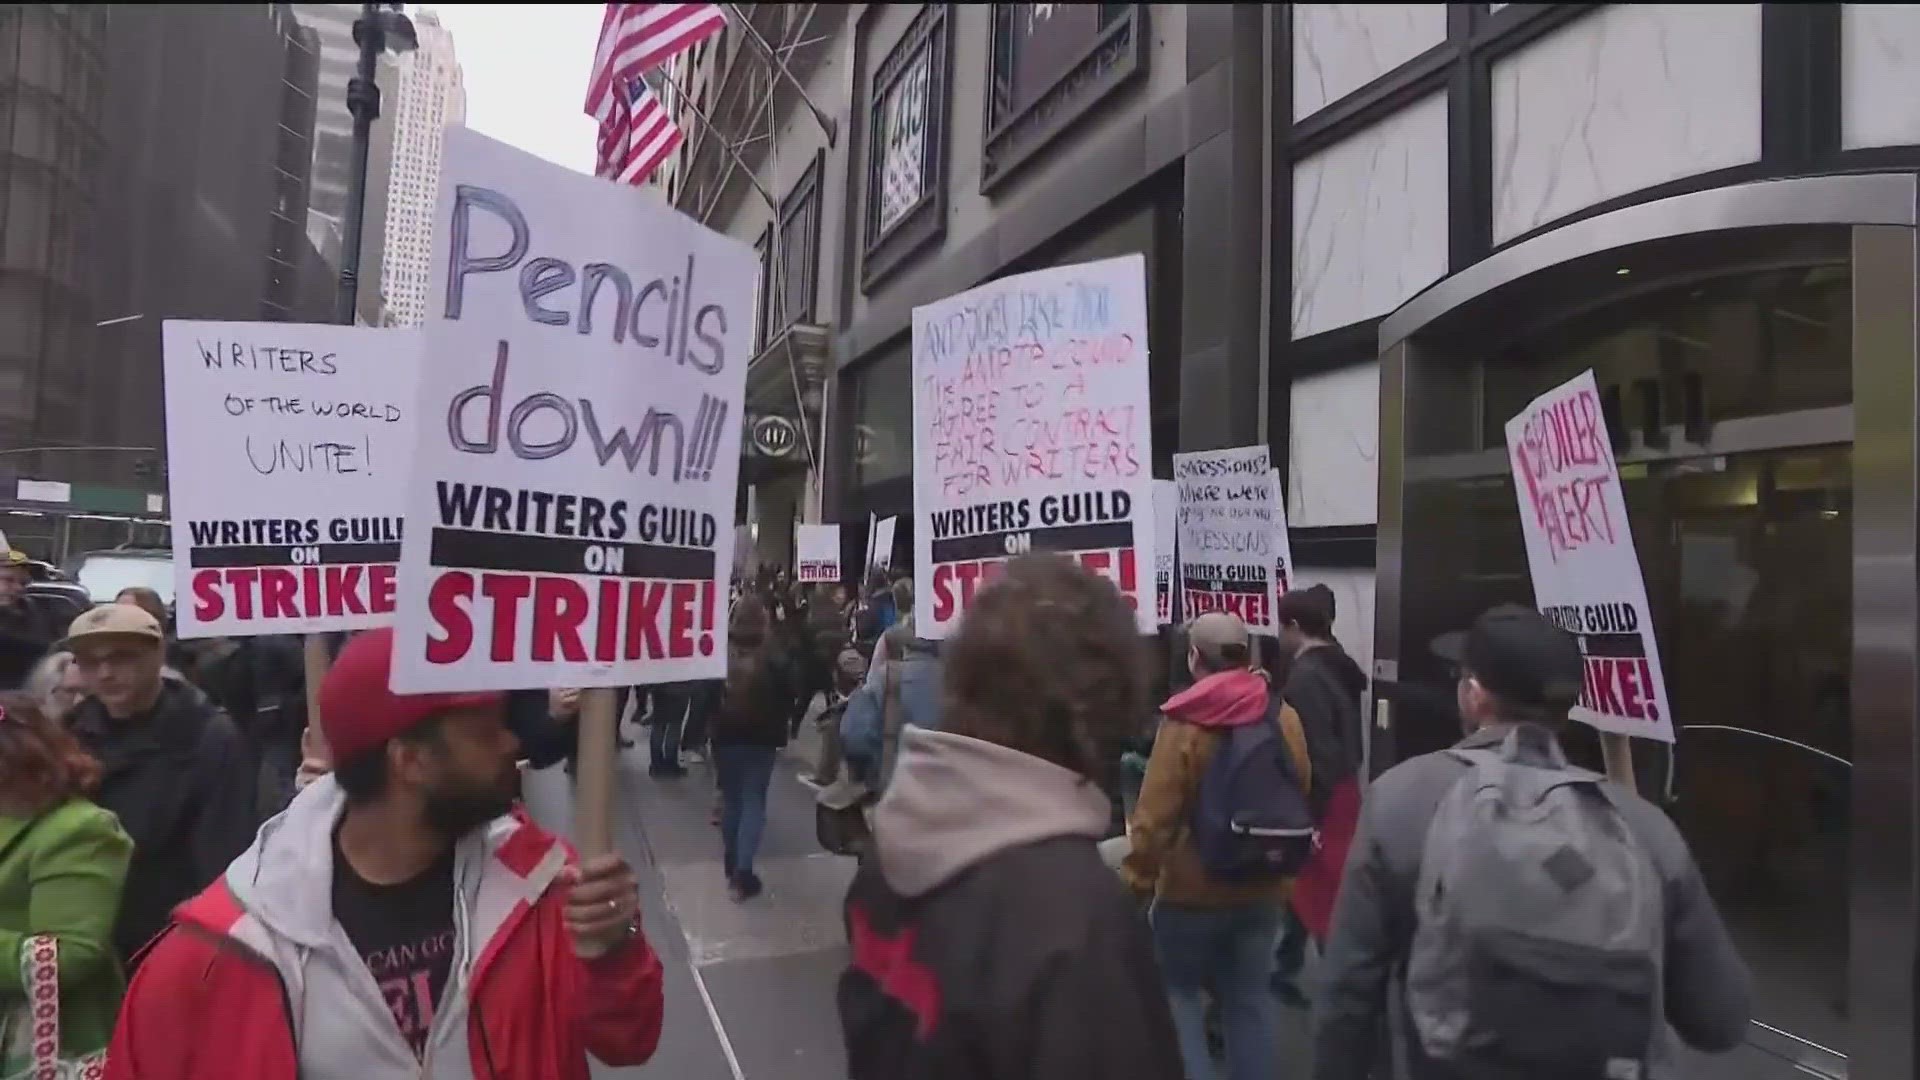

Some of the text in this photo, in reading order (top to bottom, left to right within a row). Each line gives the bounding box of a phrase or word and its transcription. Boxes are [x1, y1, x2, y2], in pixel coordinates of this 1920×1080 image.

[442, 183, 729, 376] Pencils
[197, 338, 338, 374] WRITERS
[223, 392, 402, 423] OF THE WORLD
[446, 339, 729, 484] down!!!
[245, 433, 373, 477] UNITE!
[1001, 440, 1142, 487] WRITERS
[188, 518, 320, 547] WRITERS
[436, 480, 717, 548] WRITERS GUILD
[930, 488, 1132, 539] WRITERS GUILD
[290, 546, 321, 565] ON
[583, 545, 626, 574] ON
[1004, 532, 1032, 555] ON
[1183, 562, 1223, 581] WRITERS
[1226, 563, 1268, 581] GUILD
[425, 570, 717, 665] STRIKE!
[1584, 601, 1639, 634] GUILD
[1577, 657, 1660, 723] IKE!
